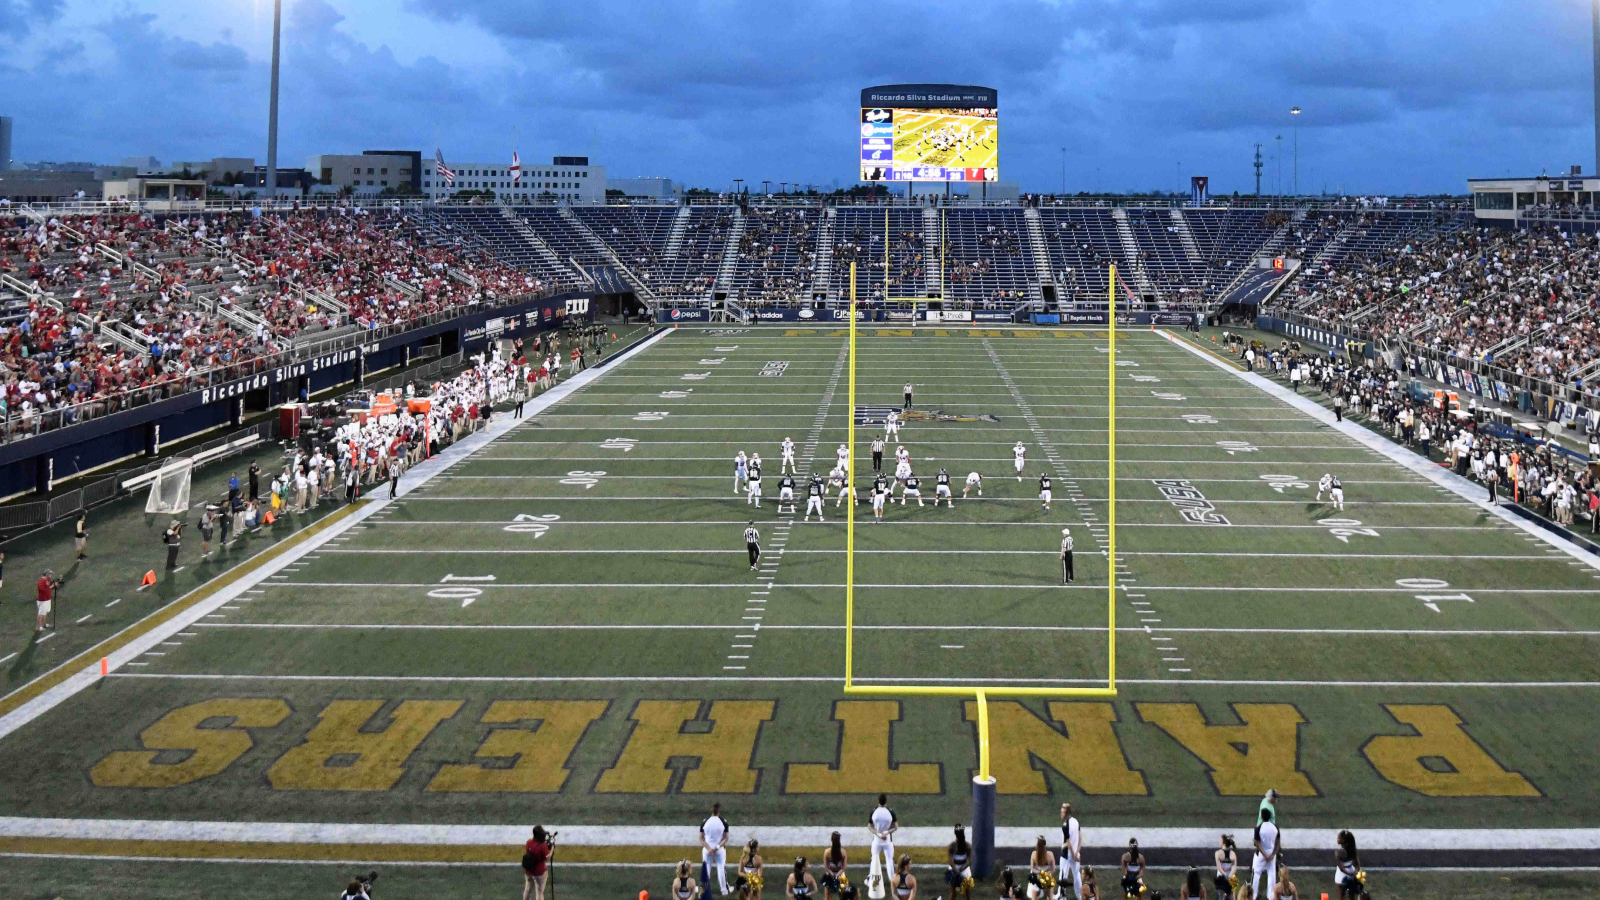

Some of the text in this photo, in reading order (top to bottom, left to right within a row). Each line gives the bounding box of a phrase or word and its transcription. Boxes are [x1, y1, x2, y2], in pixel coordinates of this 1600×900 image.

[971, 168, 979, 178] 7
[1274, 259, 1283, 269] 12
[565, 299, 590, 315] FIU
[761, 309, 783, 318] adidas
[202, 374, 268, 404] Riccardo
[276, 364, 306, 382] Silva
[313, 350, 356, 371] Stadium
[600, 437, 640, 449] 40
[1215, 440, 1259, 452] 40
[559, 470, 607, 485] 30
[1259, 474, 1310, 489] 30
[503, 513, 561, 532] 20
[1317, 518, 1380, 537] 20
[427, 574, 497, 598] 10
[1395, 578, 1475, 602] 10
[90, 699, 1543, 799] PANTHERS
